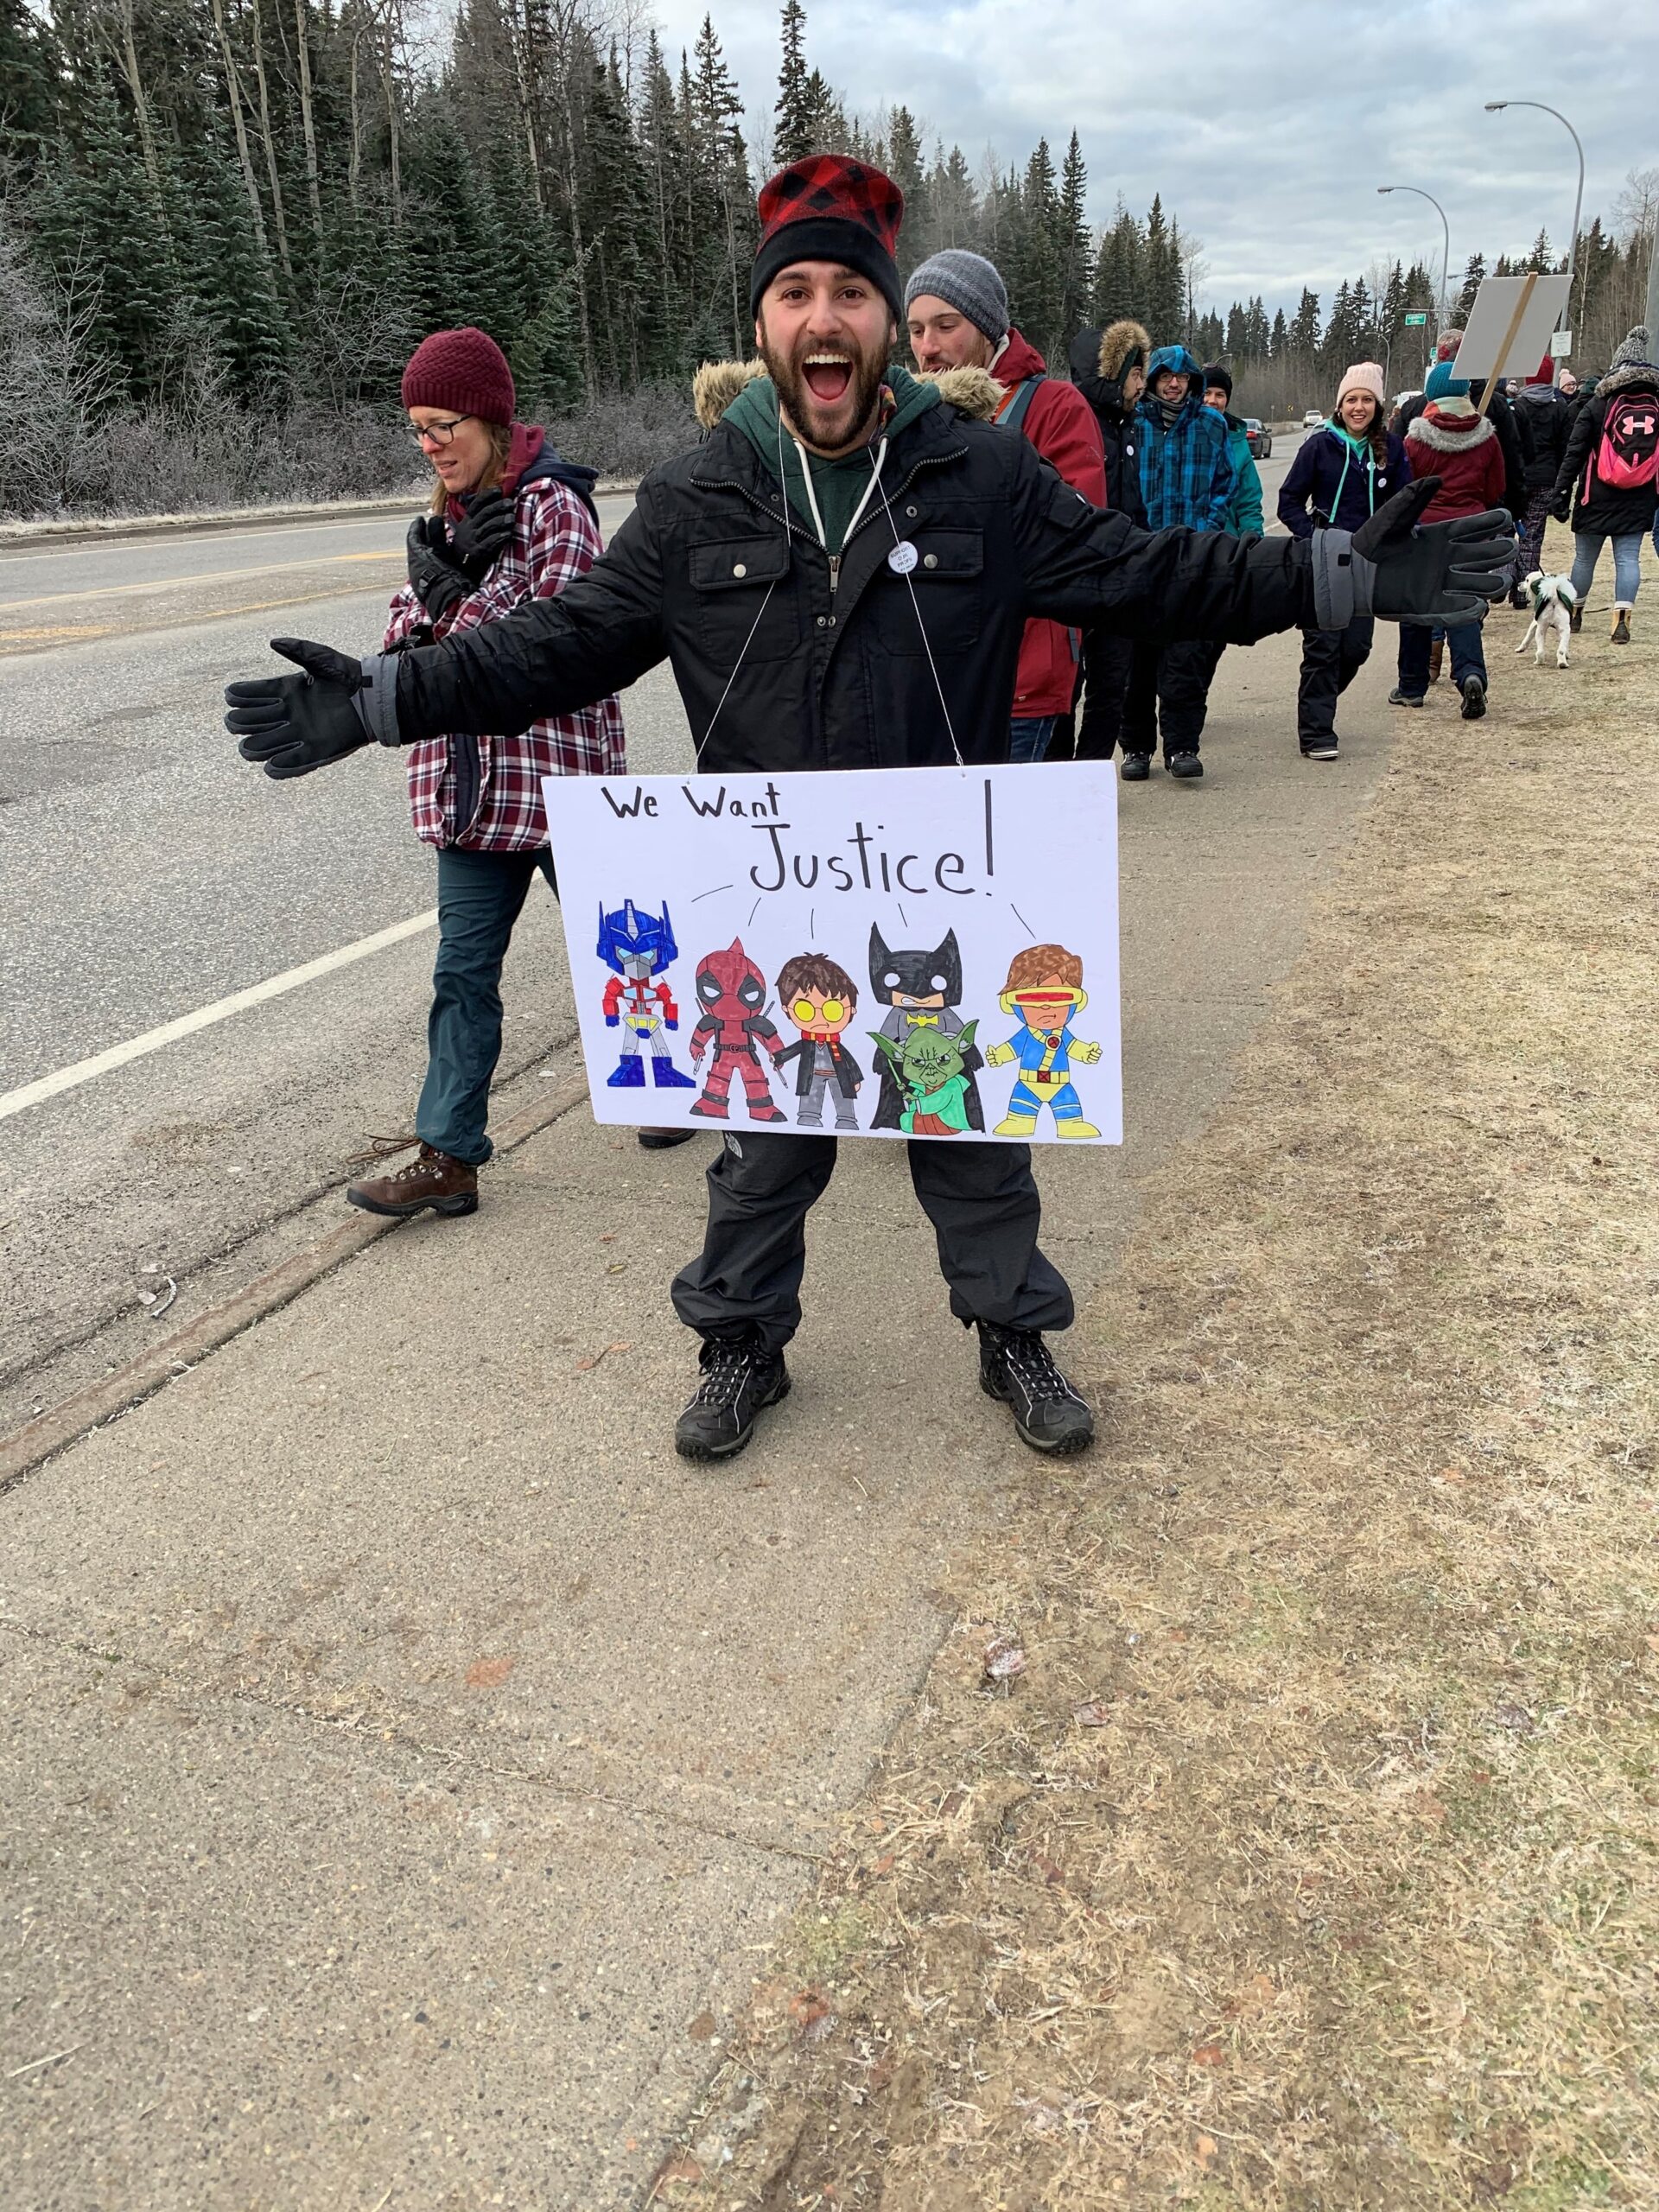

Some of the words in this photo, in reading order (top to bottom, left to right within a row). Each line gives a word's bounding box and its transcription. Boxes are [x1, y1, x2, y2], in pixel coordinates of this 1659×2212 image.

[601, 785, 658, 818] We
[681, 782, 781, 818] Want
[749, 779, 995, 897] Justice!
